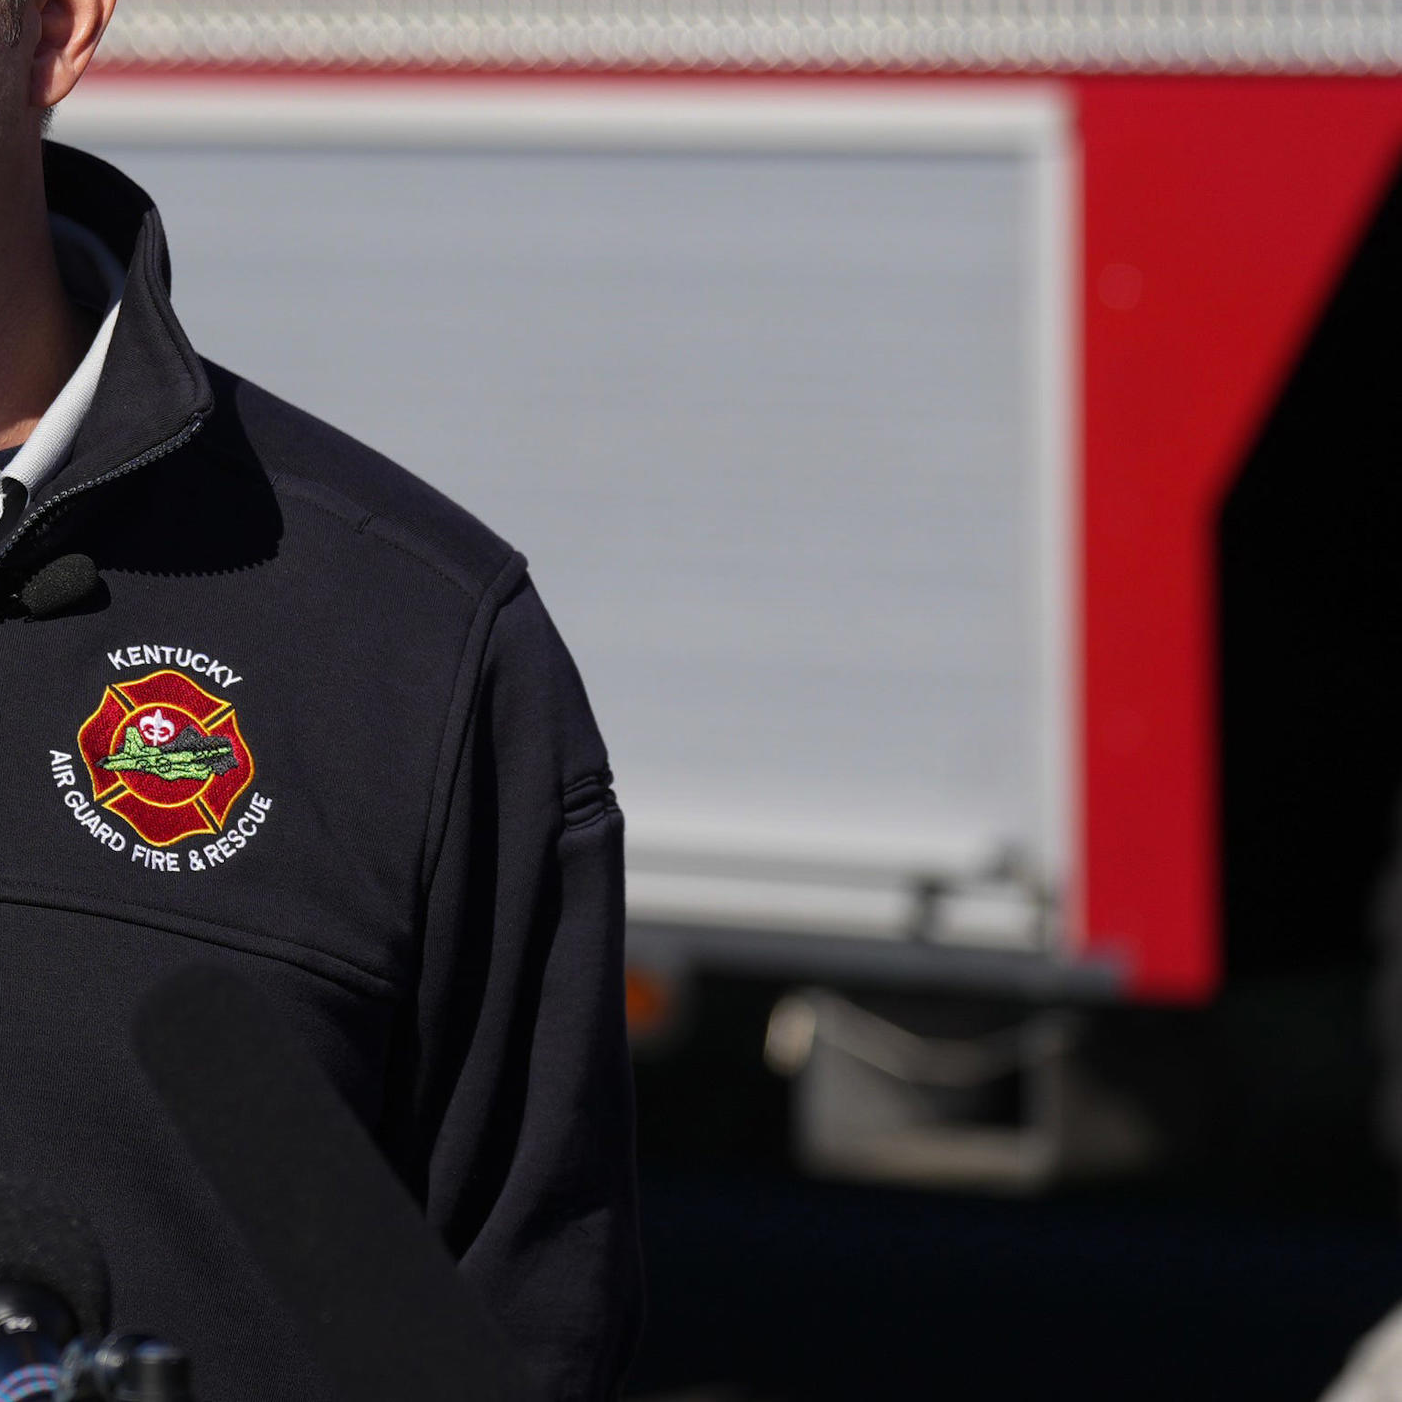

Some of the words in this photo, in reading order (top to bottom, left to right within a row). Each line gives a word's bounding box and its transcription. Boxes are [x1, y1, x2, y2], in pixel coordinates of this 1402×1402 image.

[107, 644, 243, 688] KENTUCKY
[49, 749, 76, 788] AIR
[64, 790, 126, 852] GUARD
[131, 844, 180, 873] FIRE
[188, 850, 206, 872] &
[203, 792, 273, 867] RESCUE
